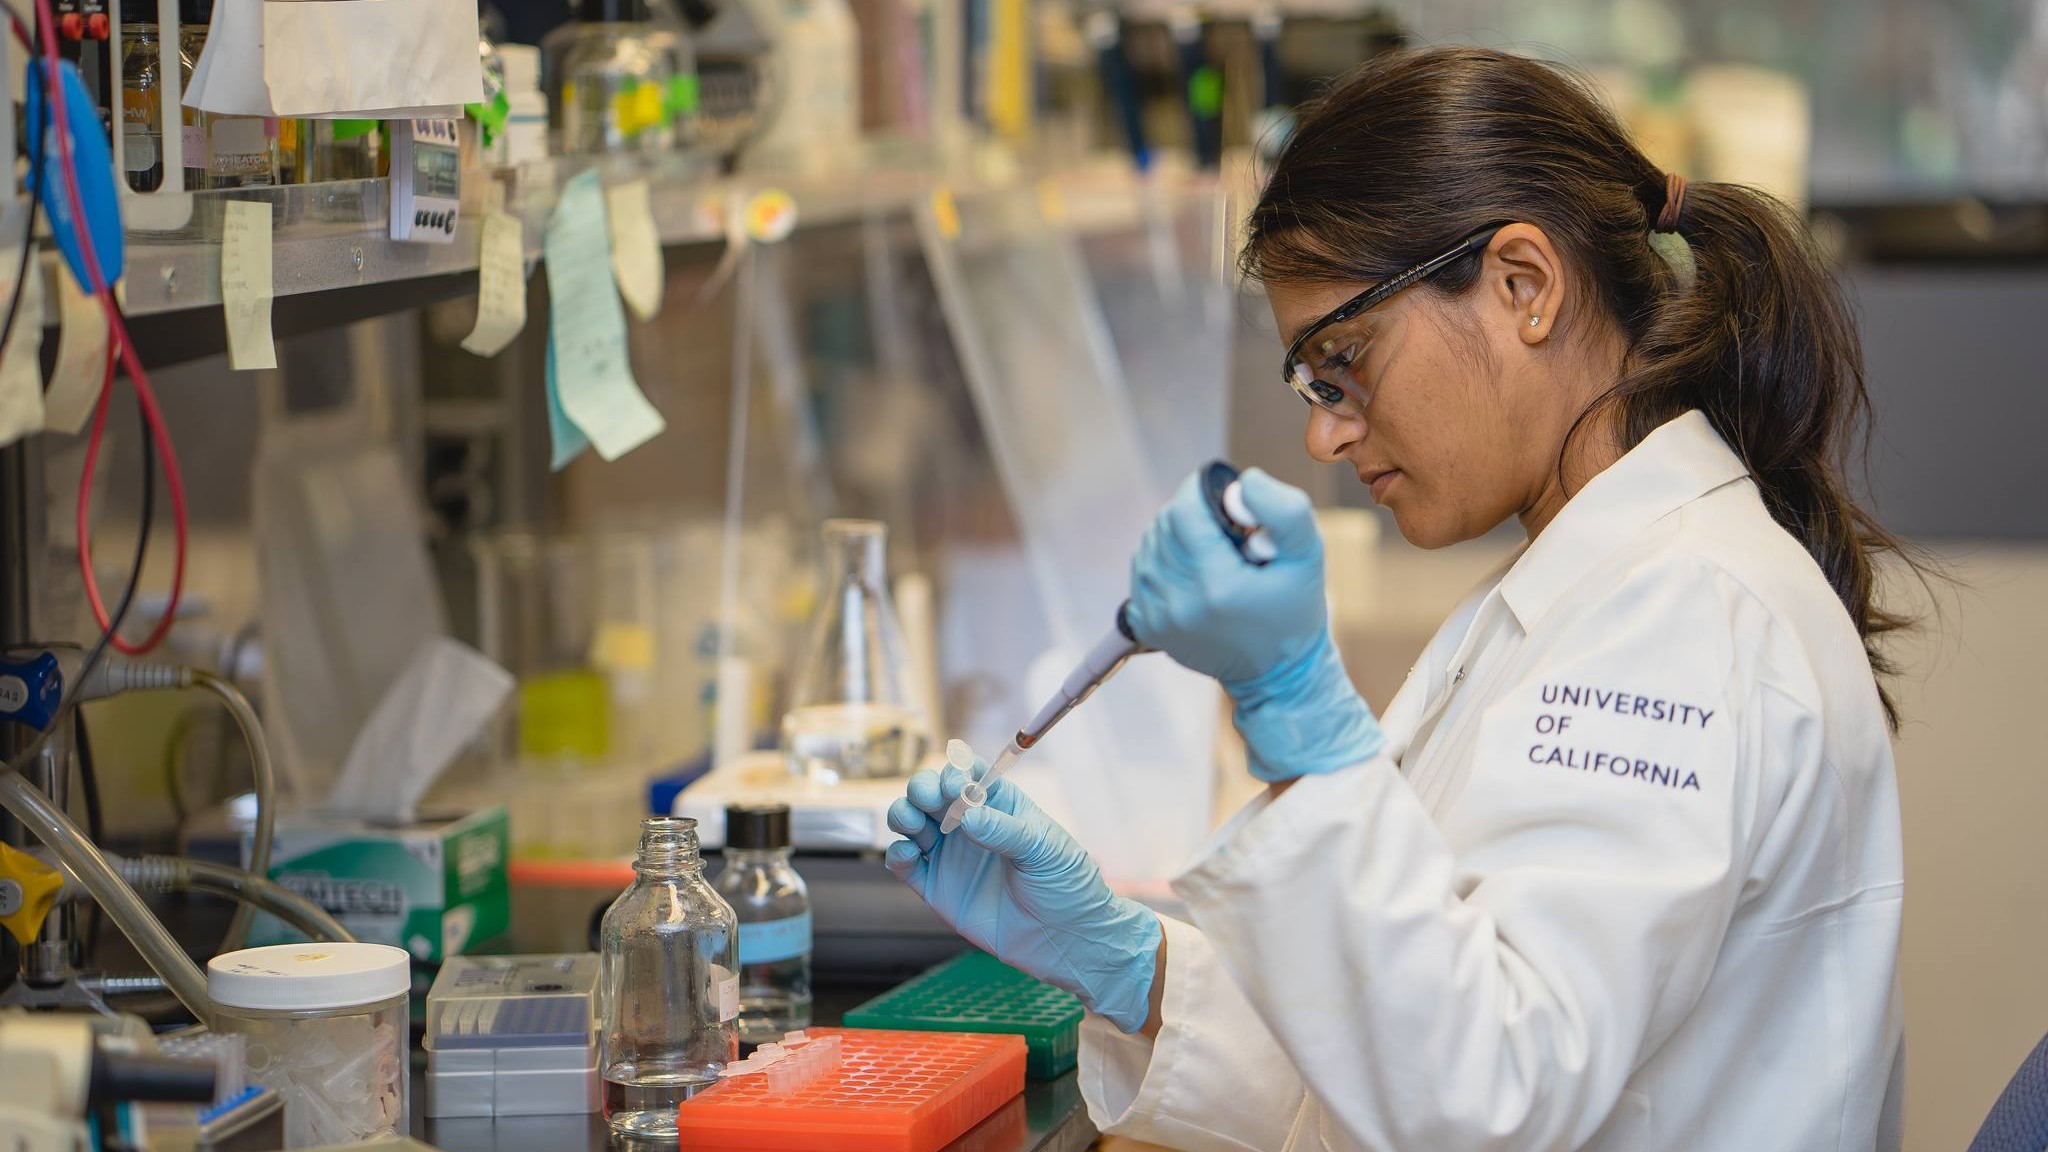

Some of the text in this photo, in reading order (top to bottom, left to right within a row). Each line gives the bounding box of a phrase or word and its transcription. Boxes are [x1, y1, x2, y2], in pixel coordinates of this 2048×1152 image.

[1535, 715, 1572, 734] OF
[1541, 684, 1714, 728] UNIVERSITY
[1529, 745, 1700, 790] CALIFORNIA
